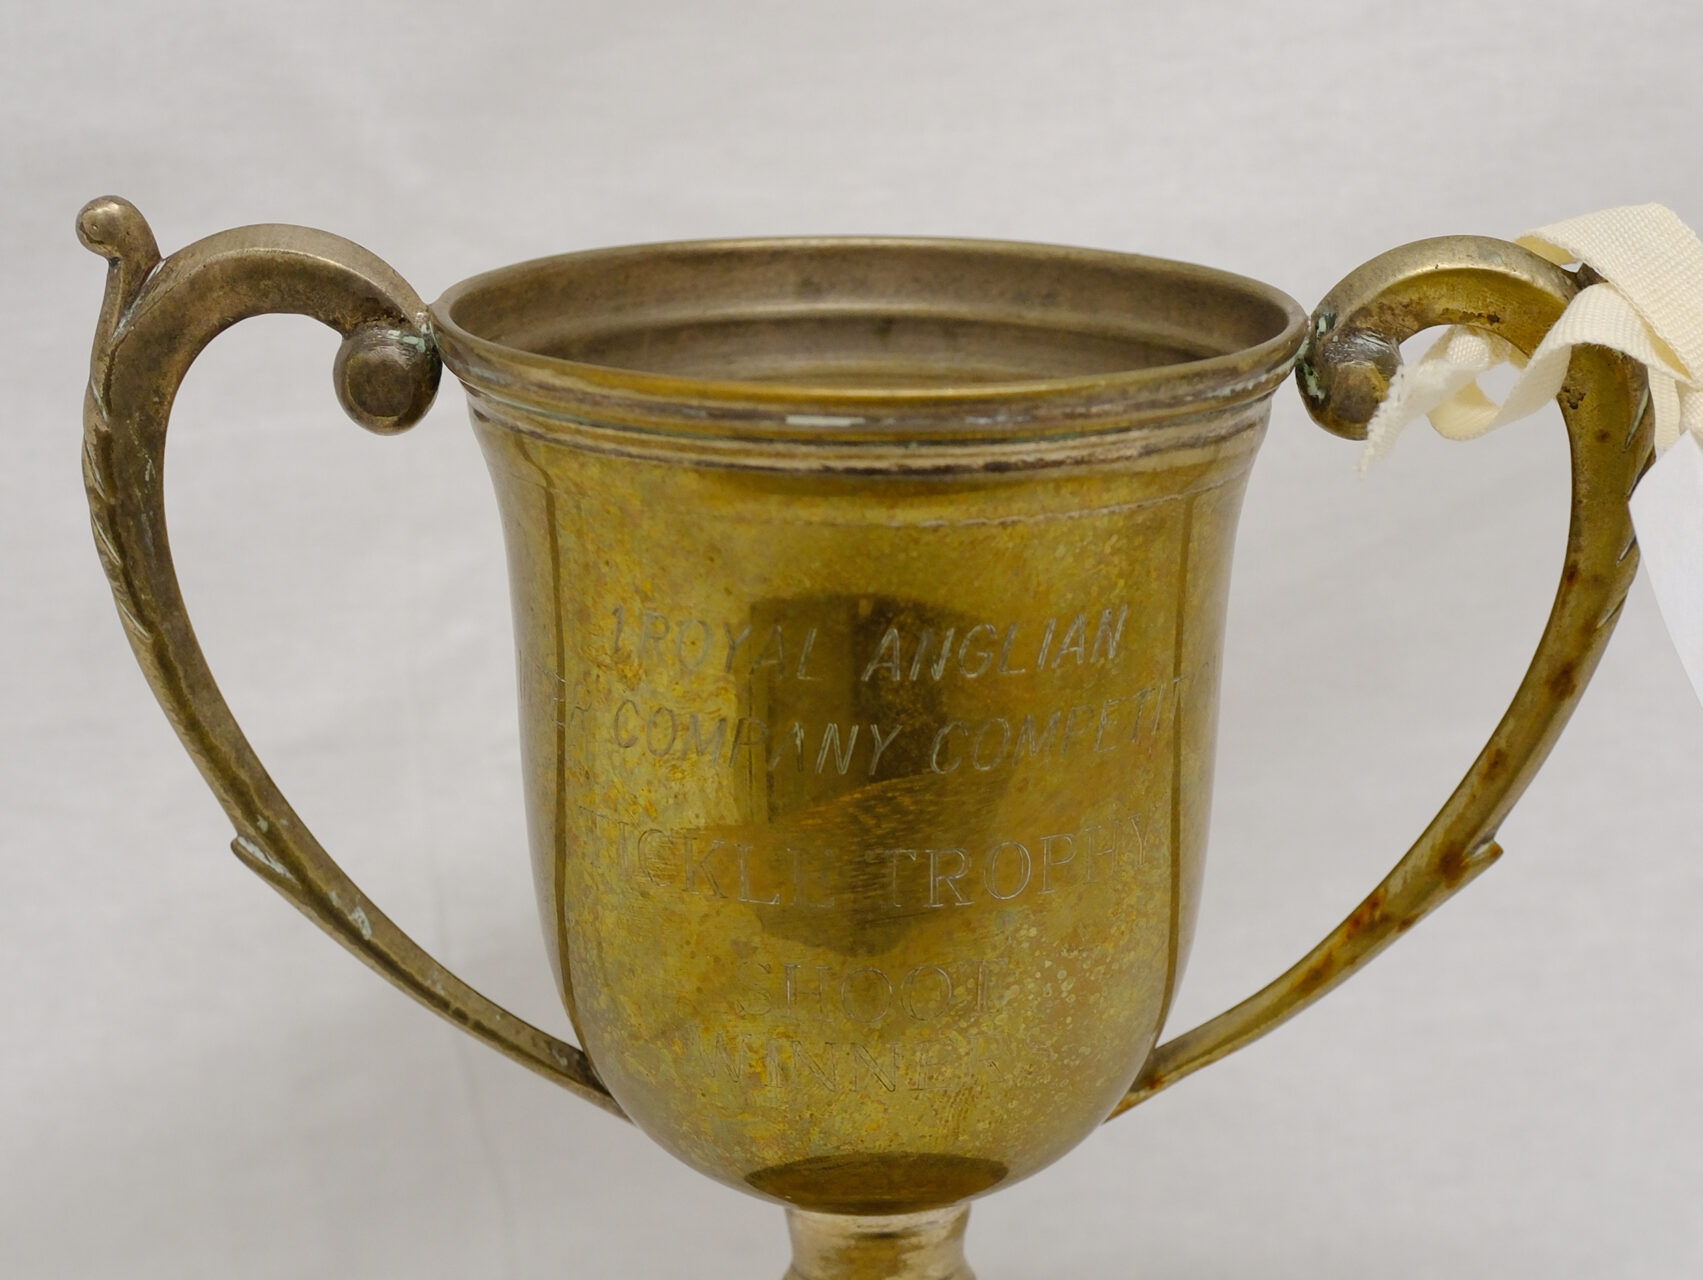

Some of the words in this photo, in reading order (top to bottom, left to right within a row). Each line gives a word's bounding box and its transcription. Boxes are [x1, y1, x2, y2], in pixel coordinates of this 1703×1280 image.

[860, 604, 1128, 682] ANGLIAN
[613, 699, 902, 776] COMPANY
[879, 811, 1151, 909] TROPHY
[733, 957, 1006, 1023] SHOOT
